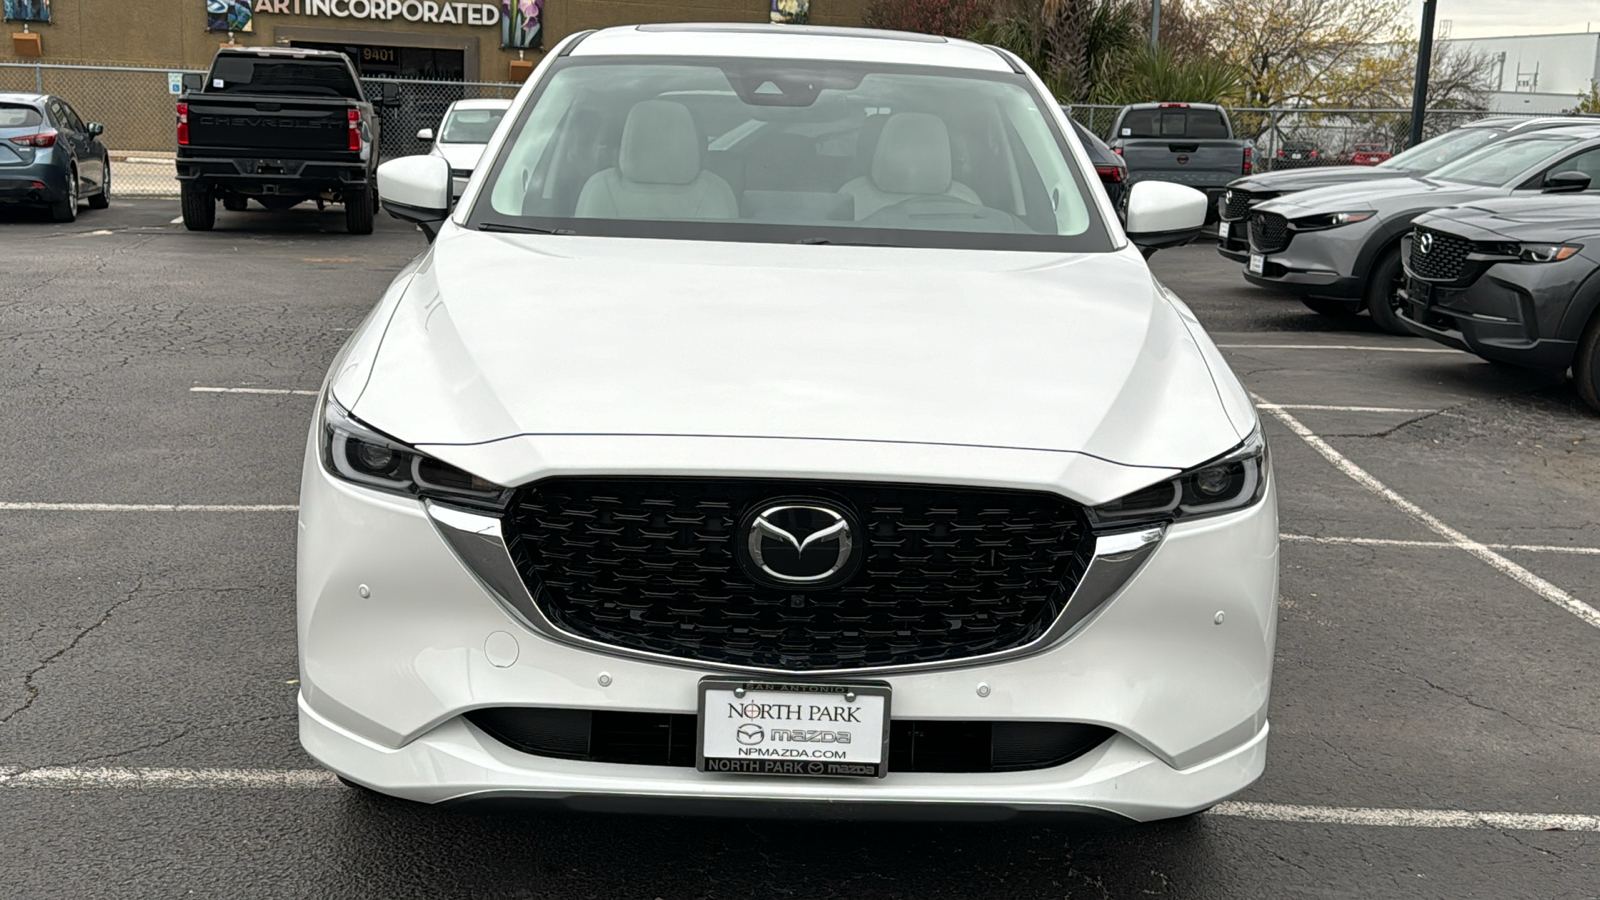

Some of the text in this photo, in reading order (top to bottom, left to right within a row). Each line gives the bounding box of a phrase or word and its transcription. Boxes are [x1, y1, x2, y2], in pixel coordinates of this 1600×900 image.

[363, 48, 394, 62] 9401
[200, 116, 344, 129] CHEVROLET
[745, 683, 845, 693] SAN ANTONIO
[728, 702, 861, 723] NORTH PARK
[738, 747, 846, 759] NPMAZDA.COM
[708, 759, 759, 772] NORTH
[764, 761, 804, 773] PARK
